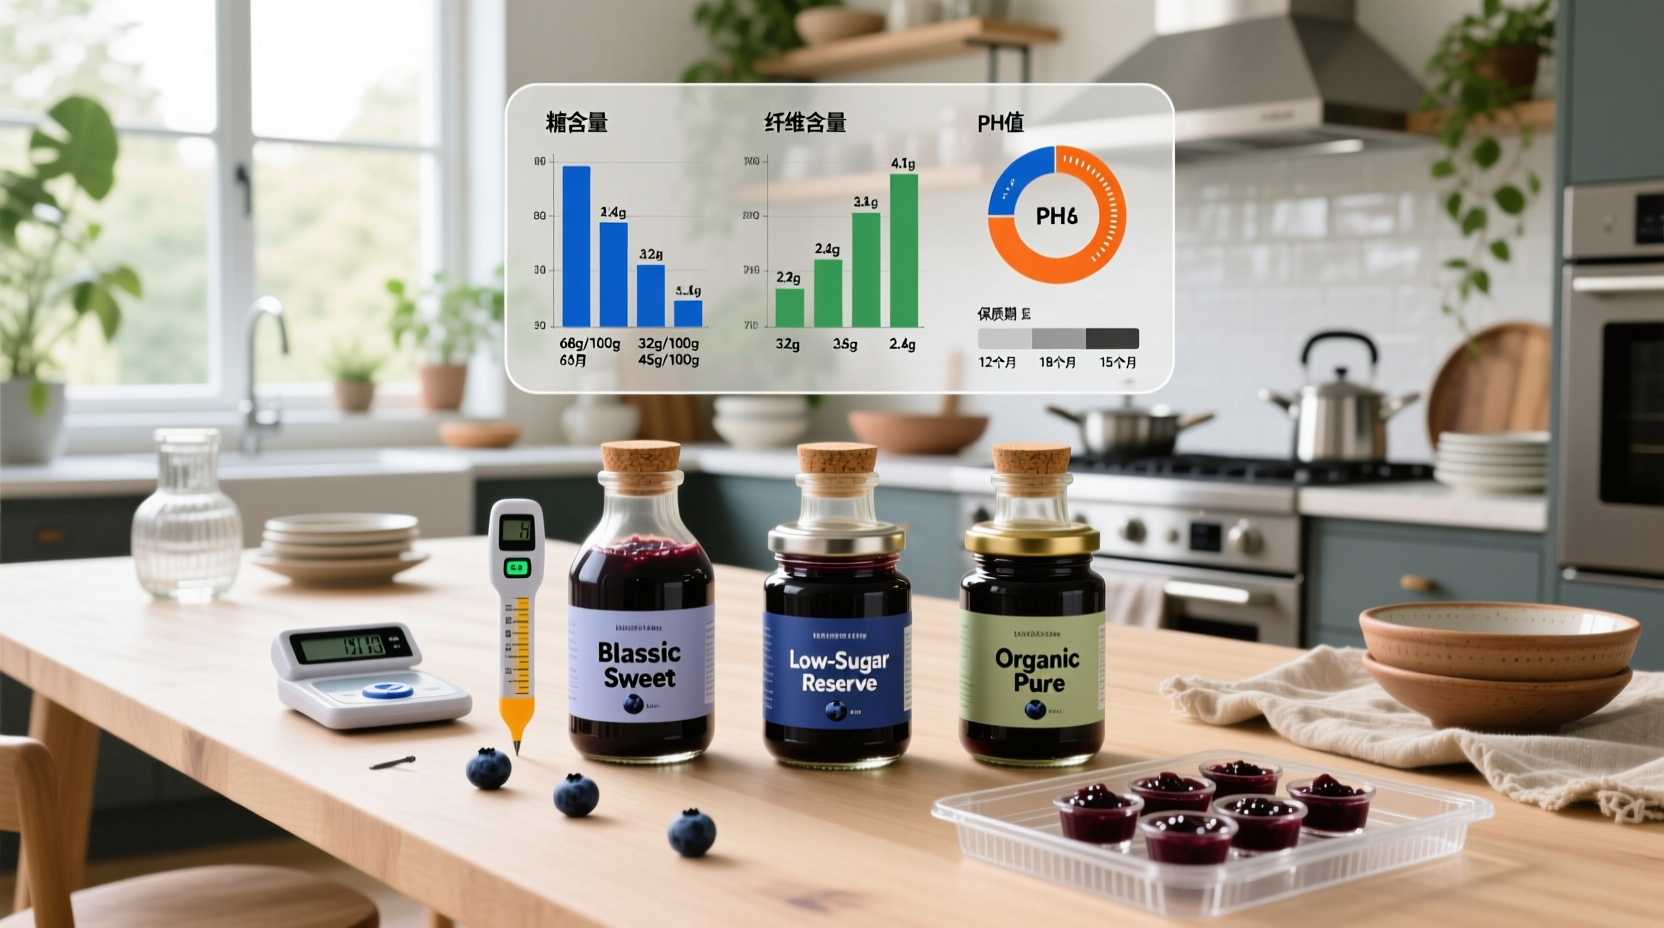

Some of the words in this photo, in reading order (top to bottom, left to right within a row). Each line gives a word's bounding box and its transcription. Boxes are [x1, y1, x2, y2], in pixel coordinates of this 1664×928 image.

[599, 641, 681, 663] Blassic
[790, 649, 889, 674] Low-Sugar
[996, 647, 1079, 673] Organic
[605, 667, 676, 688] Sweet
[803, 673, 877, 692] Reserve
[1015, 674, 1065, 693] Pure
